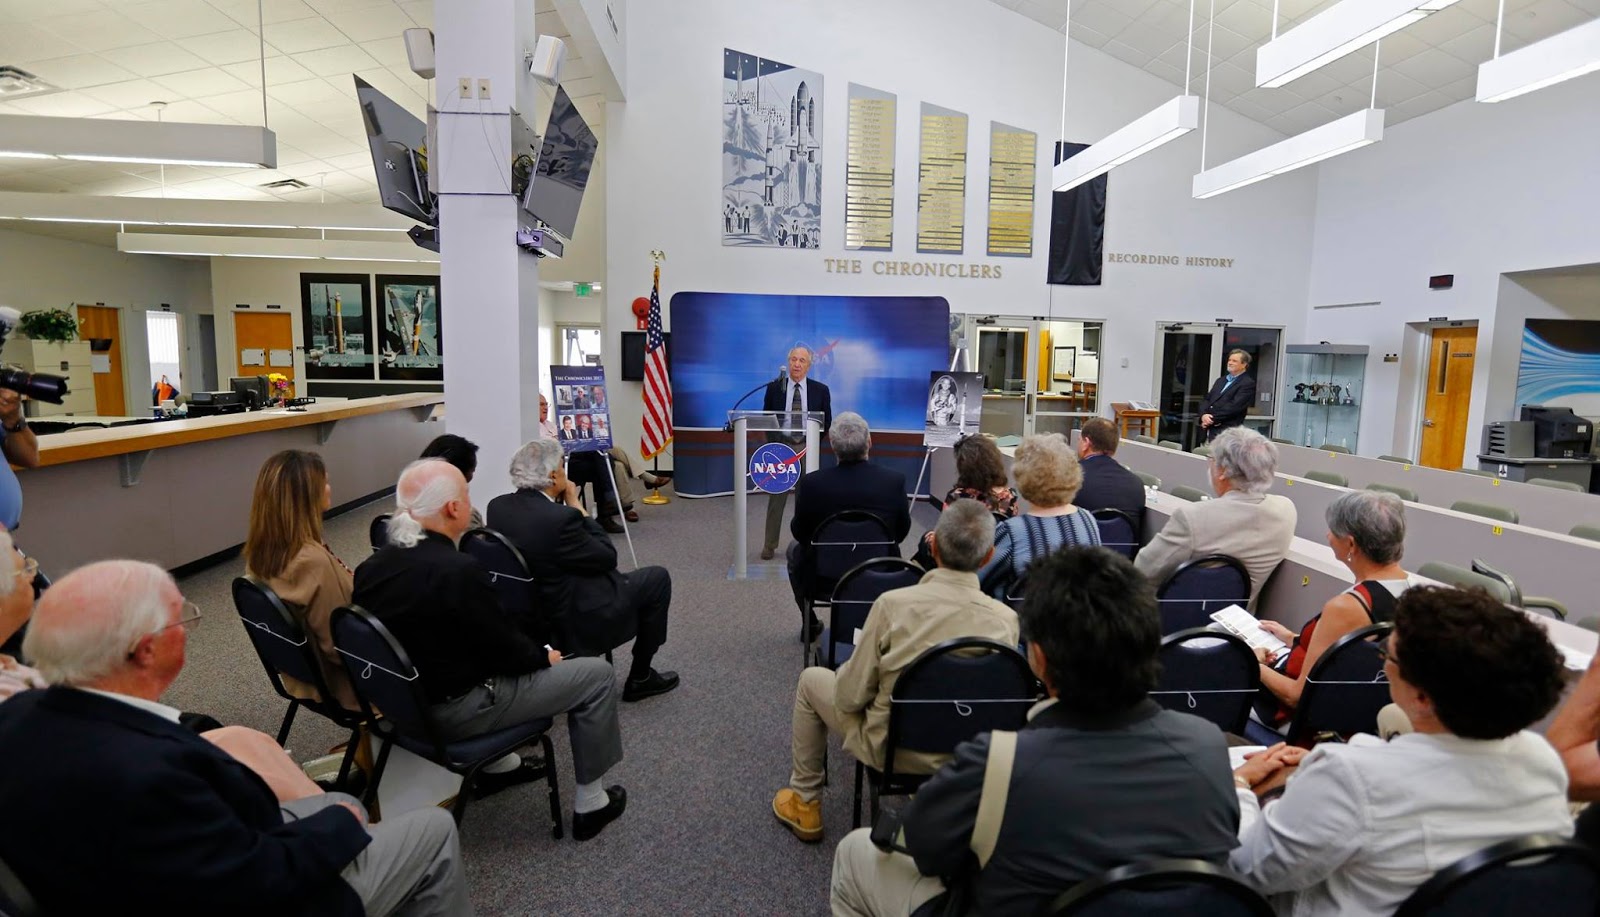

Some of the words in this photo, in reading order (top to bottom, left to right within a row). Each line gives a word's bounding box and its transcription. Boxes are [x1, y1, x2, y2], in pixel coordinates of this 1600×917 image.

[1108, 253, 1179, 265] RECORDING
[1185, 256, 1235, 268] HISTORY
[824, 258, 862, 274] THE
[872, 260, 1003, 279] CHRONICLERS
[754, 462, 797, 474] NASA
